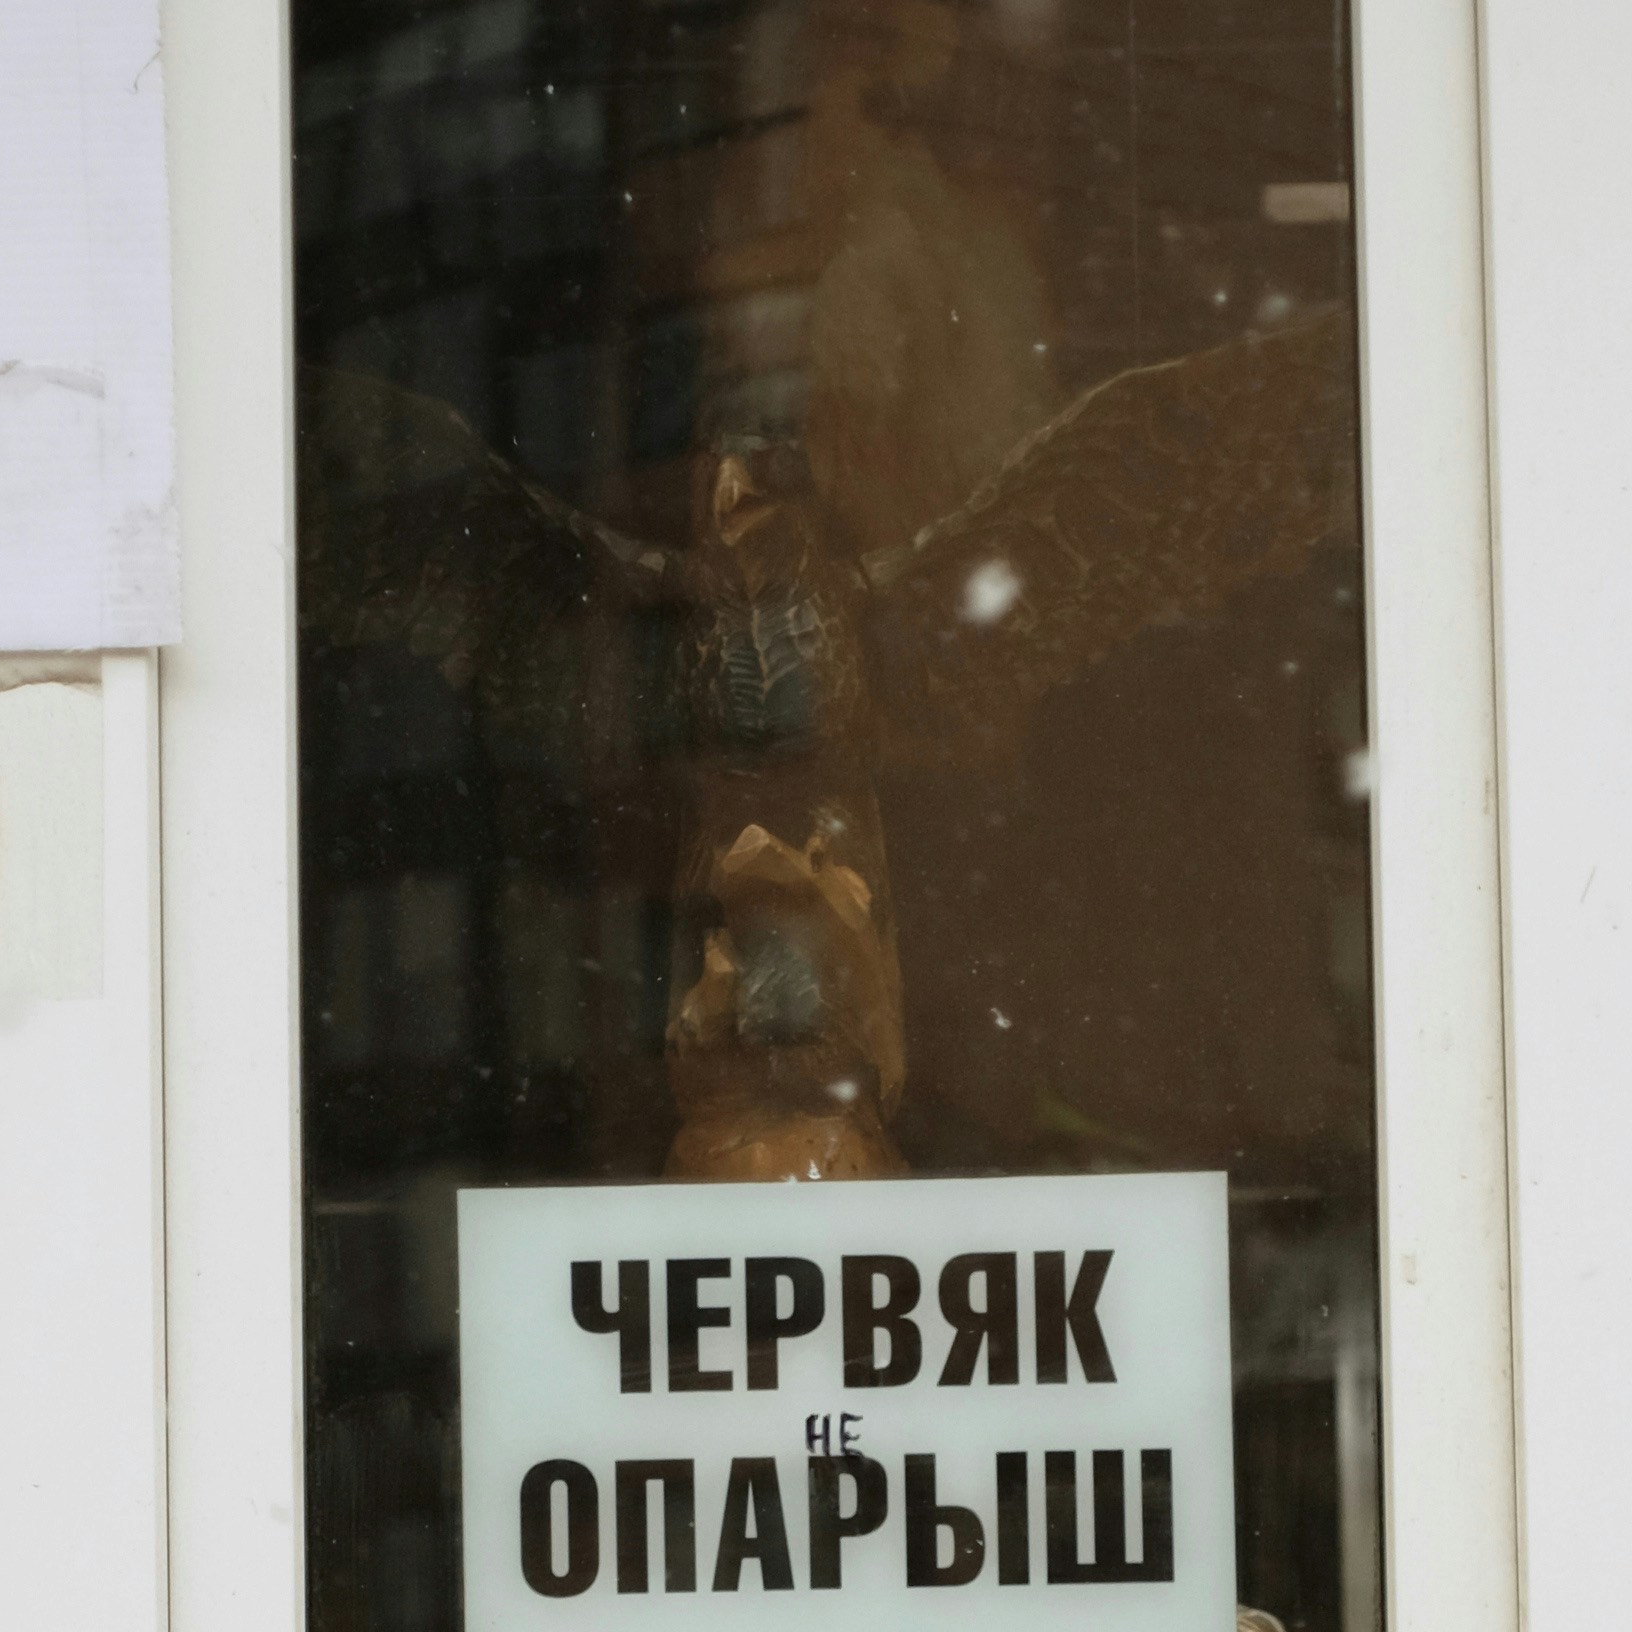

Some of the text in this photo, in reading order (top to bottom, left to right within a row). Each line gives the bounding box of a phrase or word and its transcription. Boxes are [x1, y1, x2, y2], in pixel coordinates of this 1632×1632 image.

[569, 1249, 1118, 1394] ЧЕРВЯК
[805, 1413, 865, 1456] НЕ
[519, 1447, 1176, 1599] ОПАРЫШ
